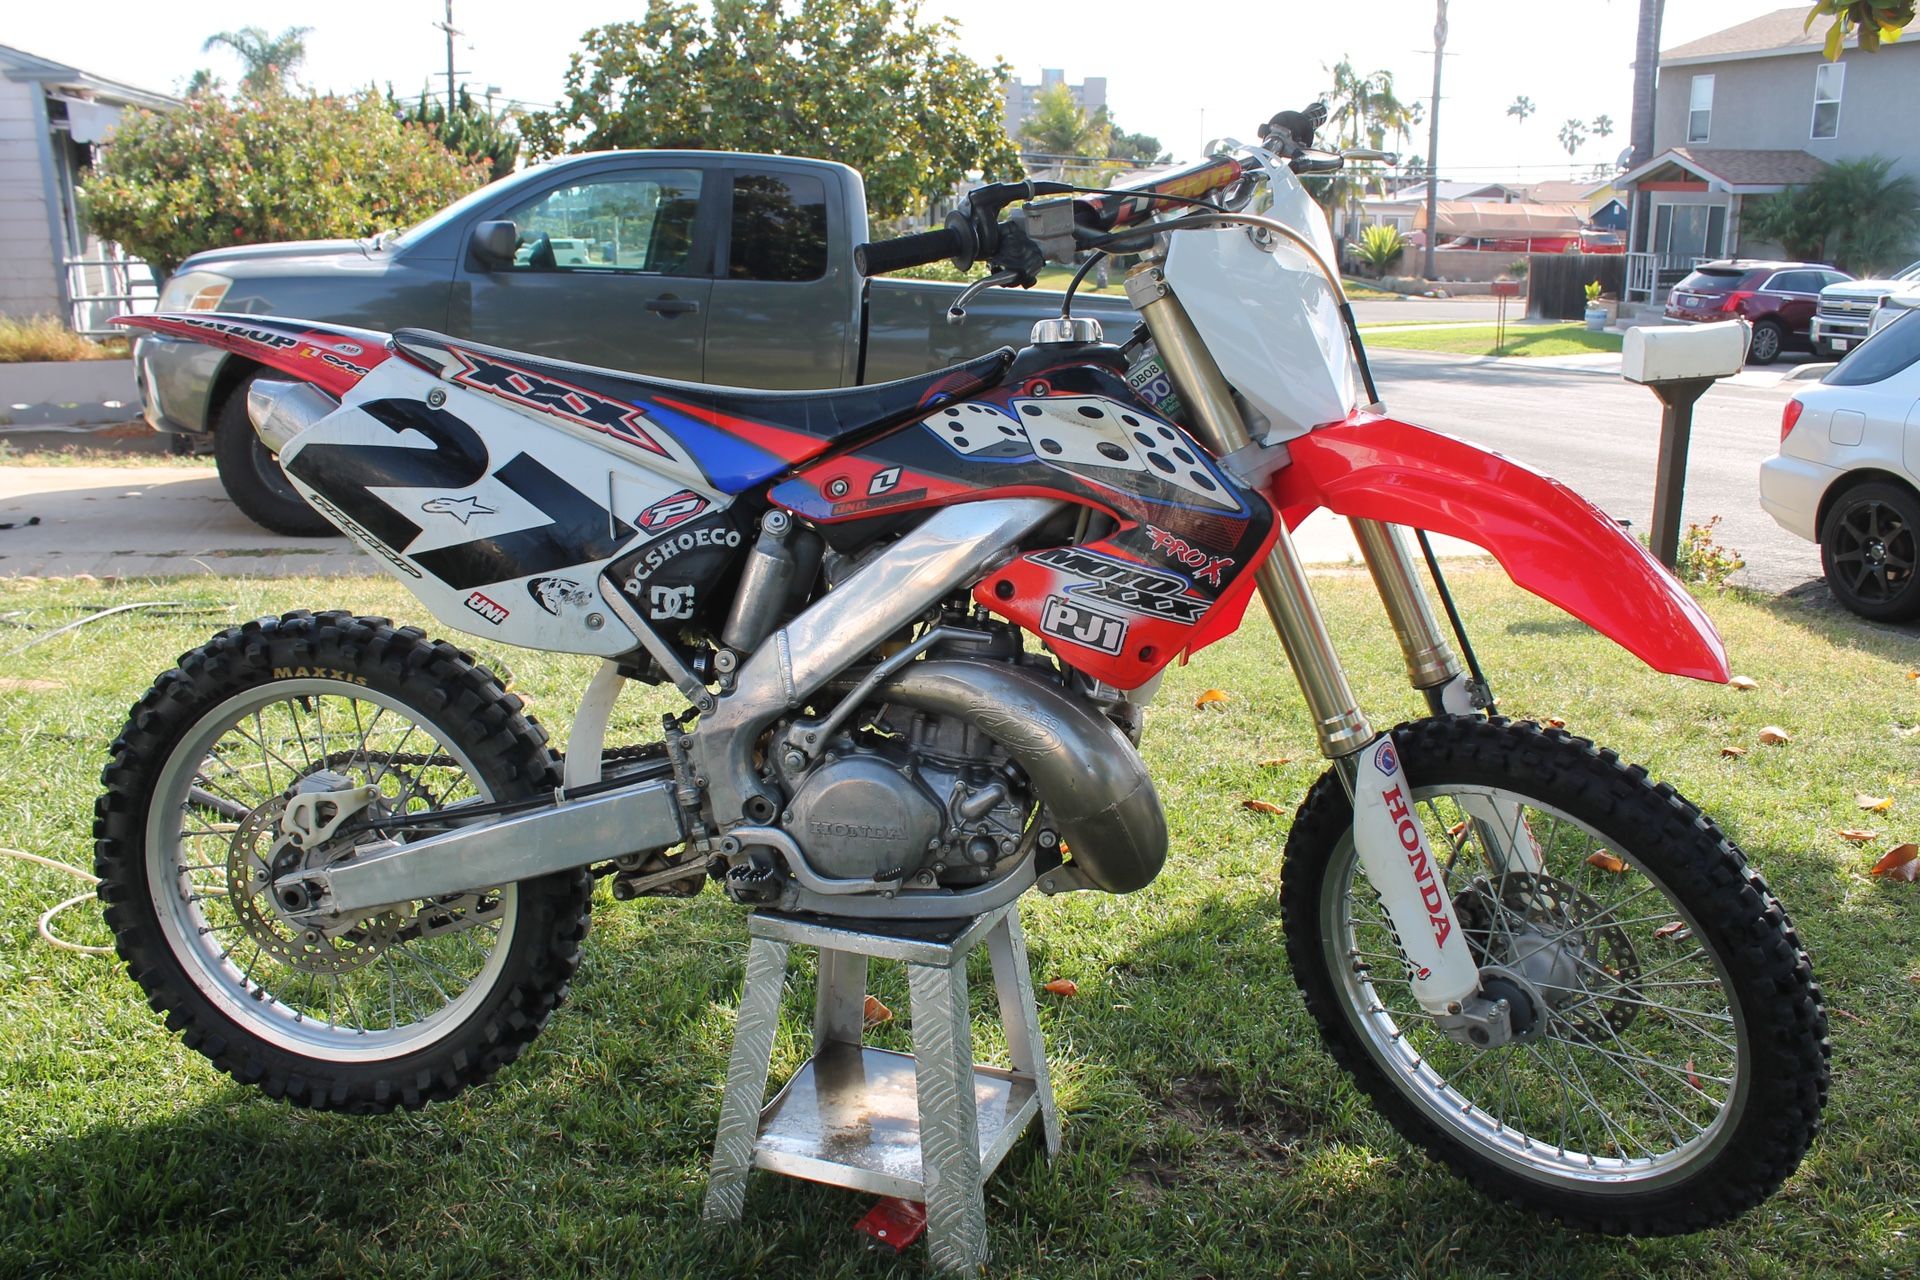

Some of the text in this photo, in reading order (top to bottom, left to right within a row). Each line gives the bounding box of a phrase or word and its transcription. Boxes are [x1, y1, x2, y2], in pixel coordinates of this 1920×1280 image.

[157, 316, 299, 349] NLOP
[285, 398, 639, 590] 21
[624, 528, 741, 597] DCSHOECO
[1034, 549, 1184, 595] MOTO
[466, 593, 508, 625] UNI
[1046, 603, 1121, 649] PJ1
[1072, 580, 1214, 626] XXX
[273, 666, 368, 686] MAXXIS
[810, 820, 909, 841] HONDA
[1382, 783, 1452, 949] HONDA
